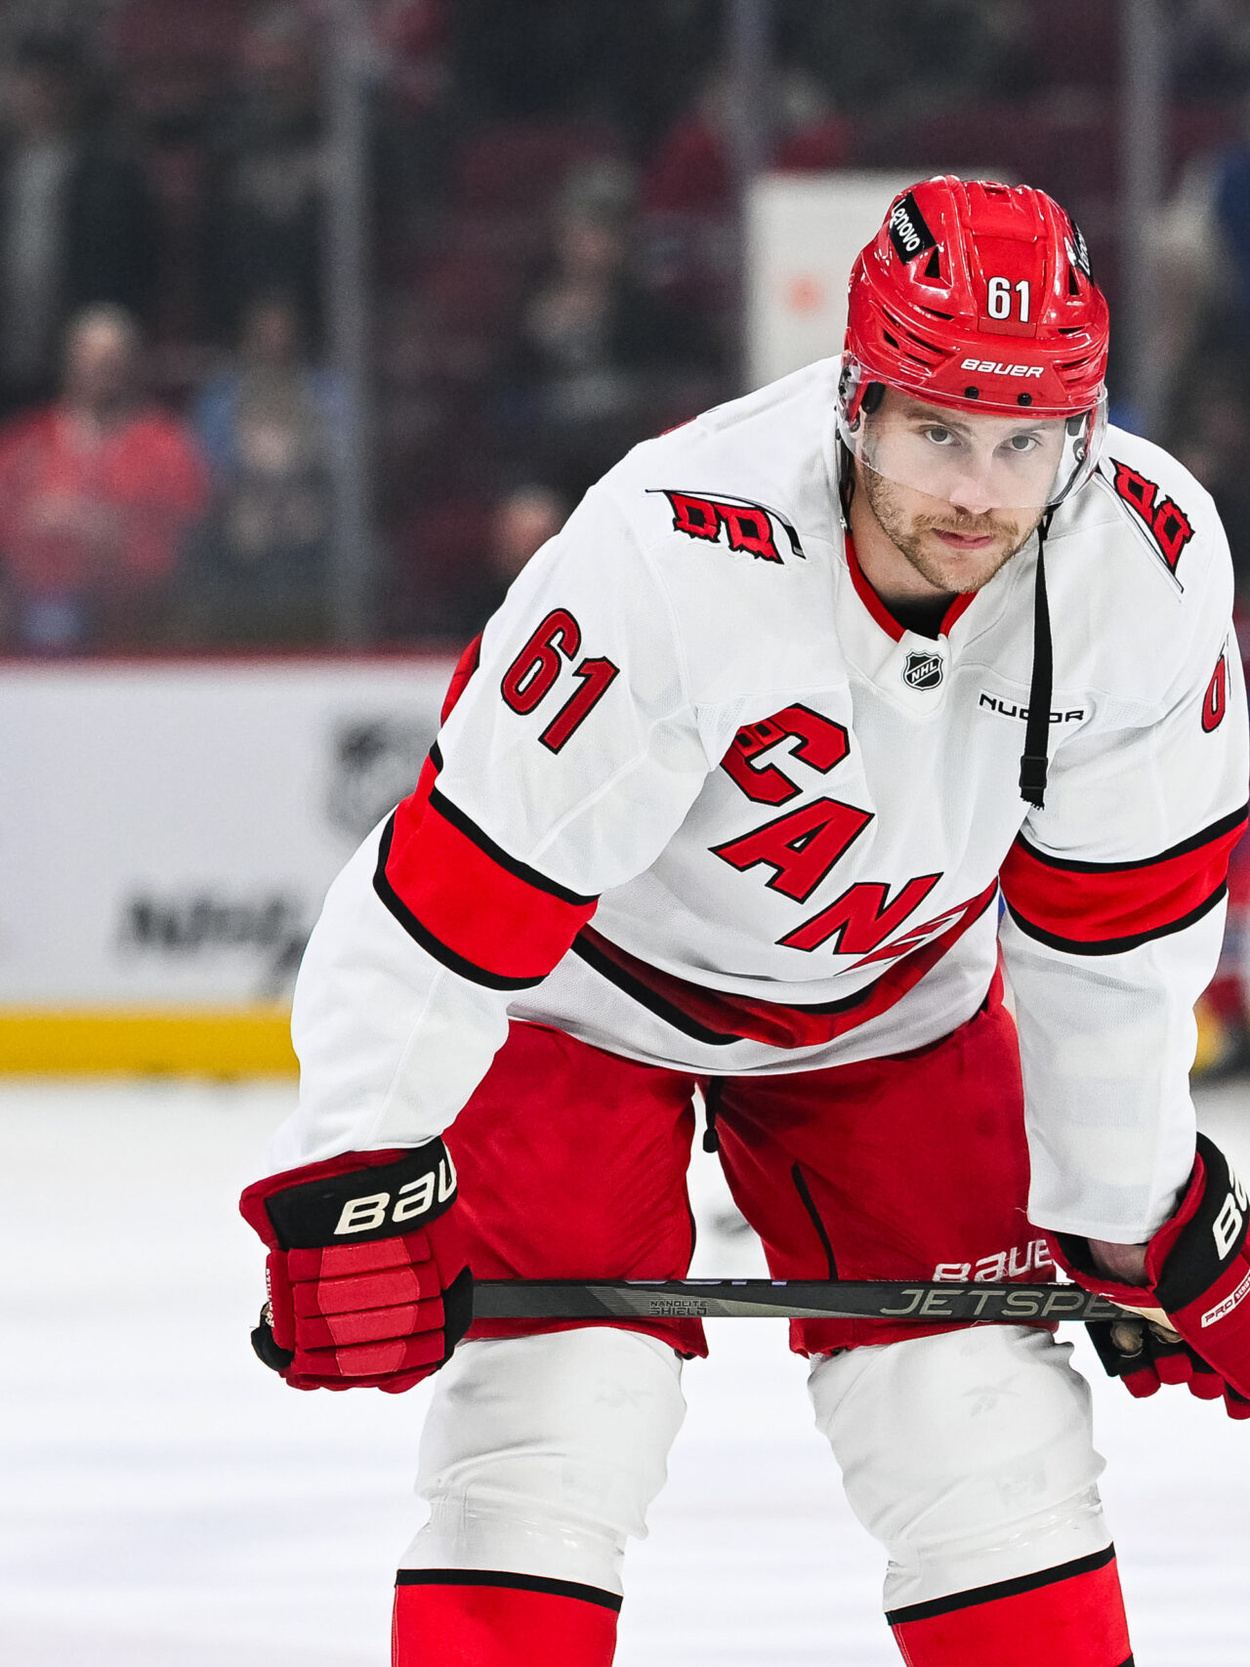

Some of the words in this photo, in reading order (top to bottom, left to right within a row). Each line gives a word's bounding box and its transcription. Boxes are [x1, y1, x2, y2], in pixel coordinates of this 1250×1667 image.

[889, 198, 921, 252] Lenovo
[987, 276, 1030, 323] 61
[500, 607, 620, 755] 61
[911, 660, 938, 682] NHL
[932, 1239, 1053, 1282] BAUE
[649, 1307, 707, 1315] SHIELD
[880, 1289, 1143, 1318] JETSPE
[1205, 1301, 1233, 1323] PRO
